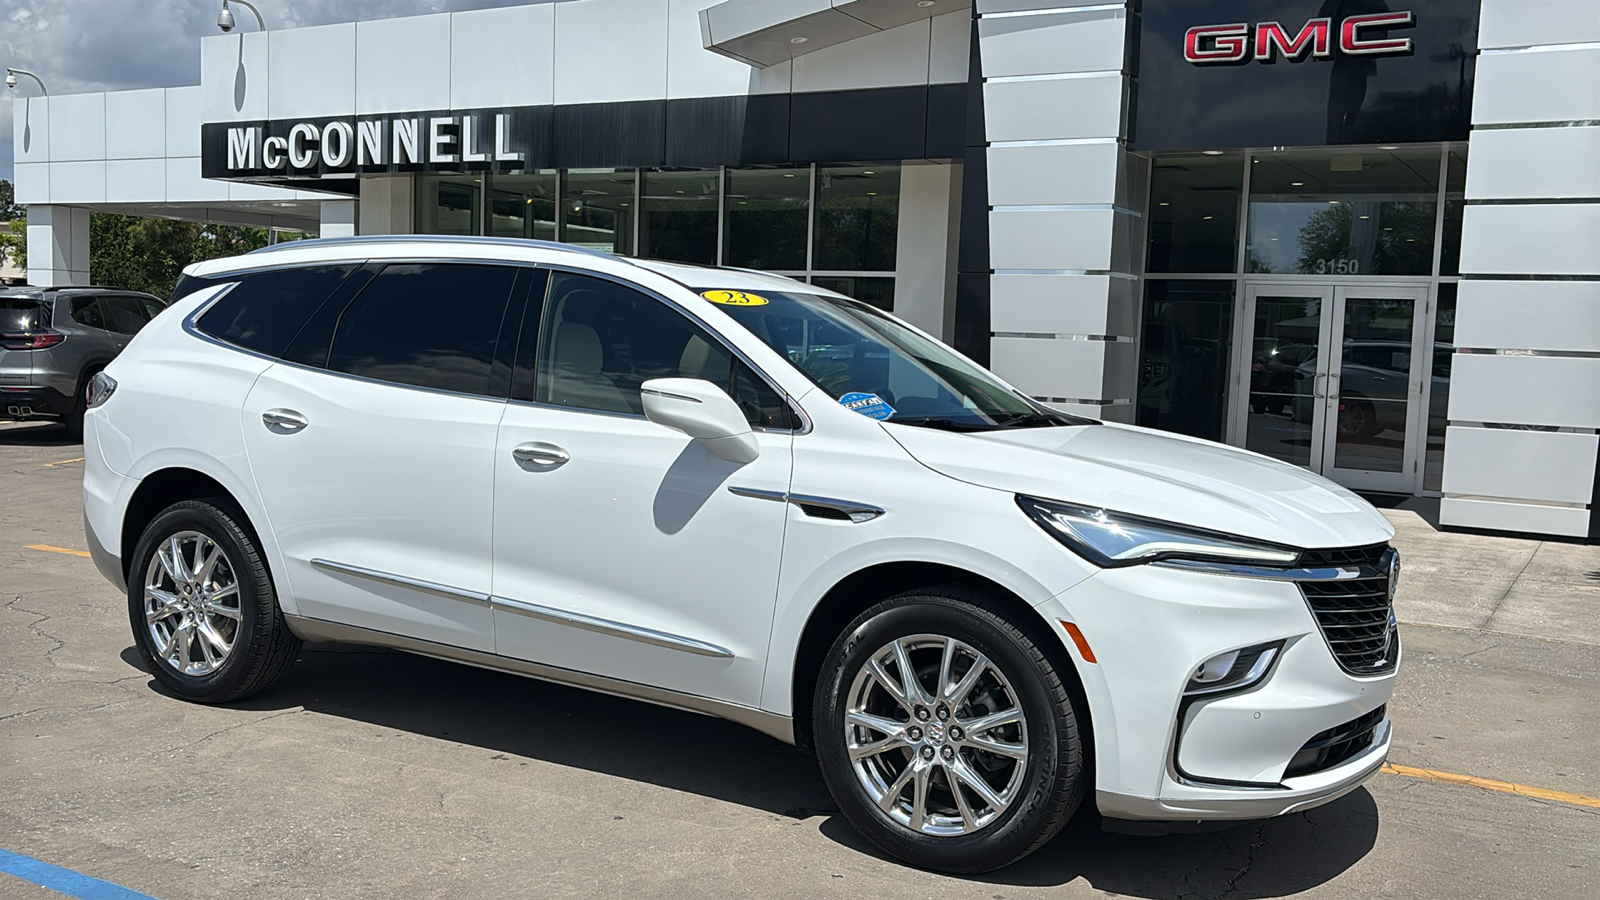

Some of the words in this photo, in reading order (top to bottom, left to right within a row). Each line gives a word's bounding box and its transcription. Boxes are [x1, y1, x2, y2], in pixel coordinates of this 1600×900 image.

[1184, 11, 1412, 62] GMC
[227, 114, 523, 170] McCONNELL
[1316, 258, 1359, 274] 3150
[721, 291, 750, 304] 23
